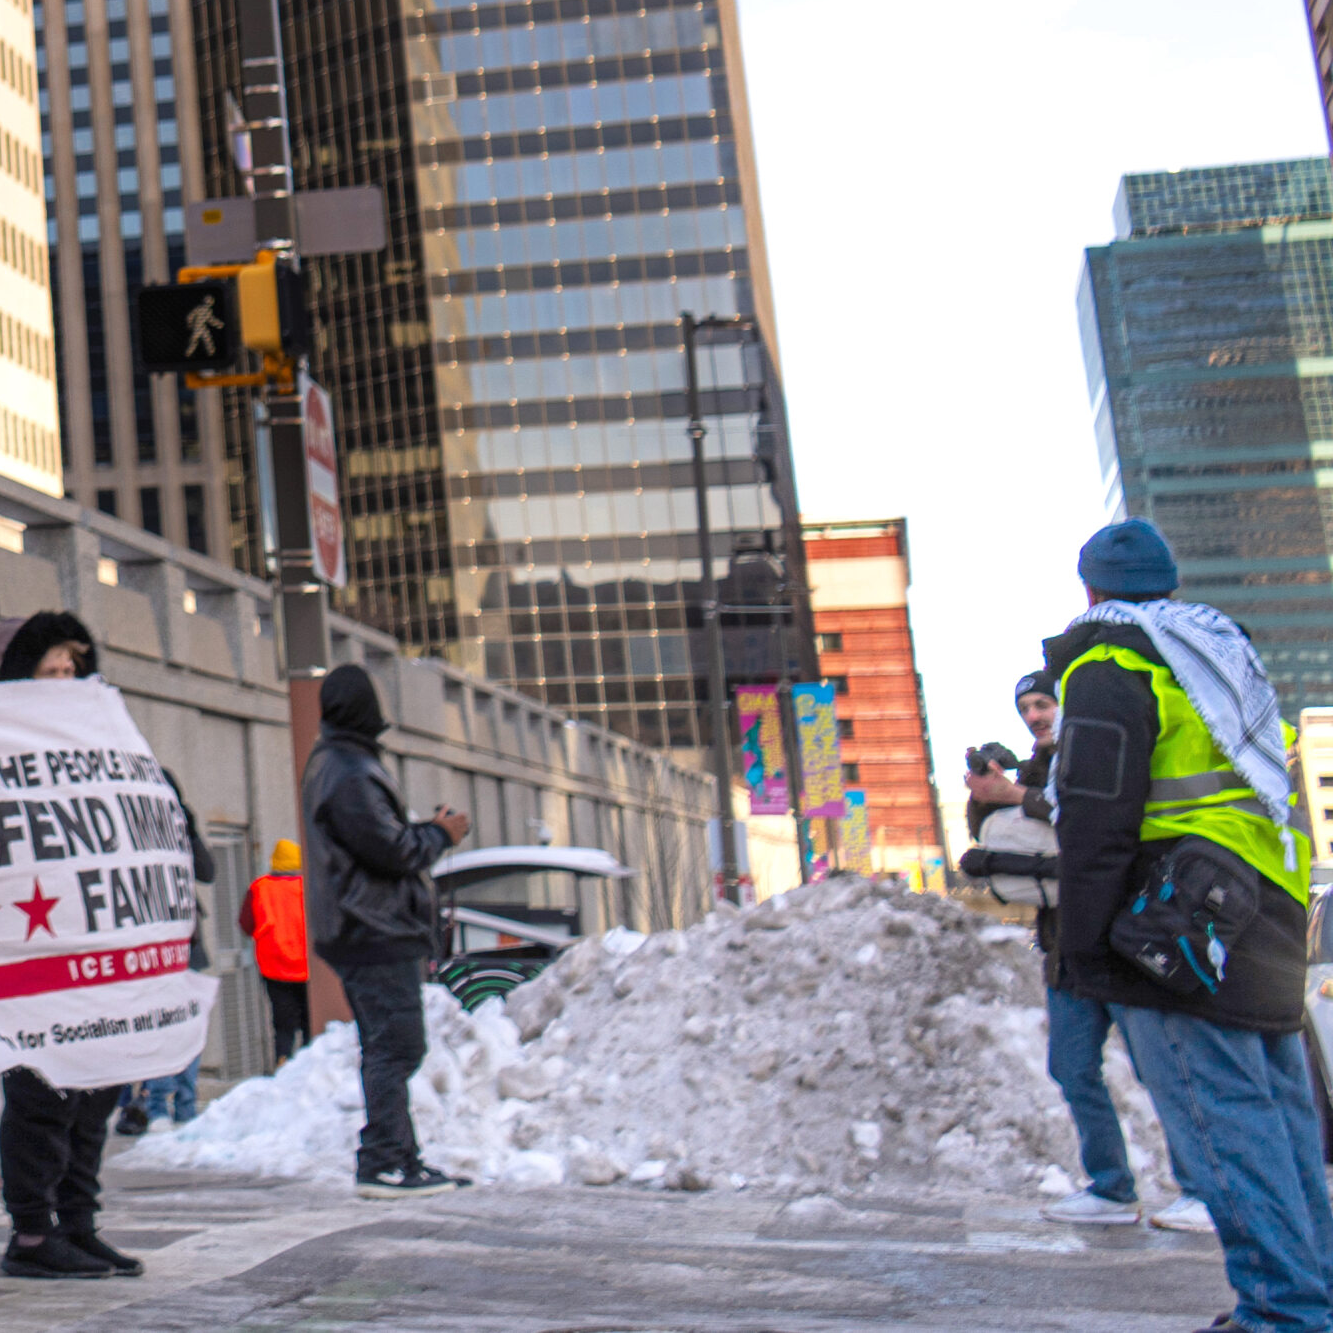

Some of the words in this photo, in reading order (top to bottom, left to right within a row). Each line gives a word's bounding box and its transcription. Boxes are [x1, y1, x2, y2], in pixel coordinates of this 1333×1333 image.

[44, 749, 124, 785] PEOPLE
[67, 955, 115, 982] ICE
[17, 1030, 47, 1050] for
